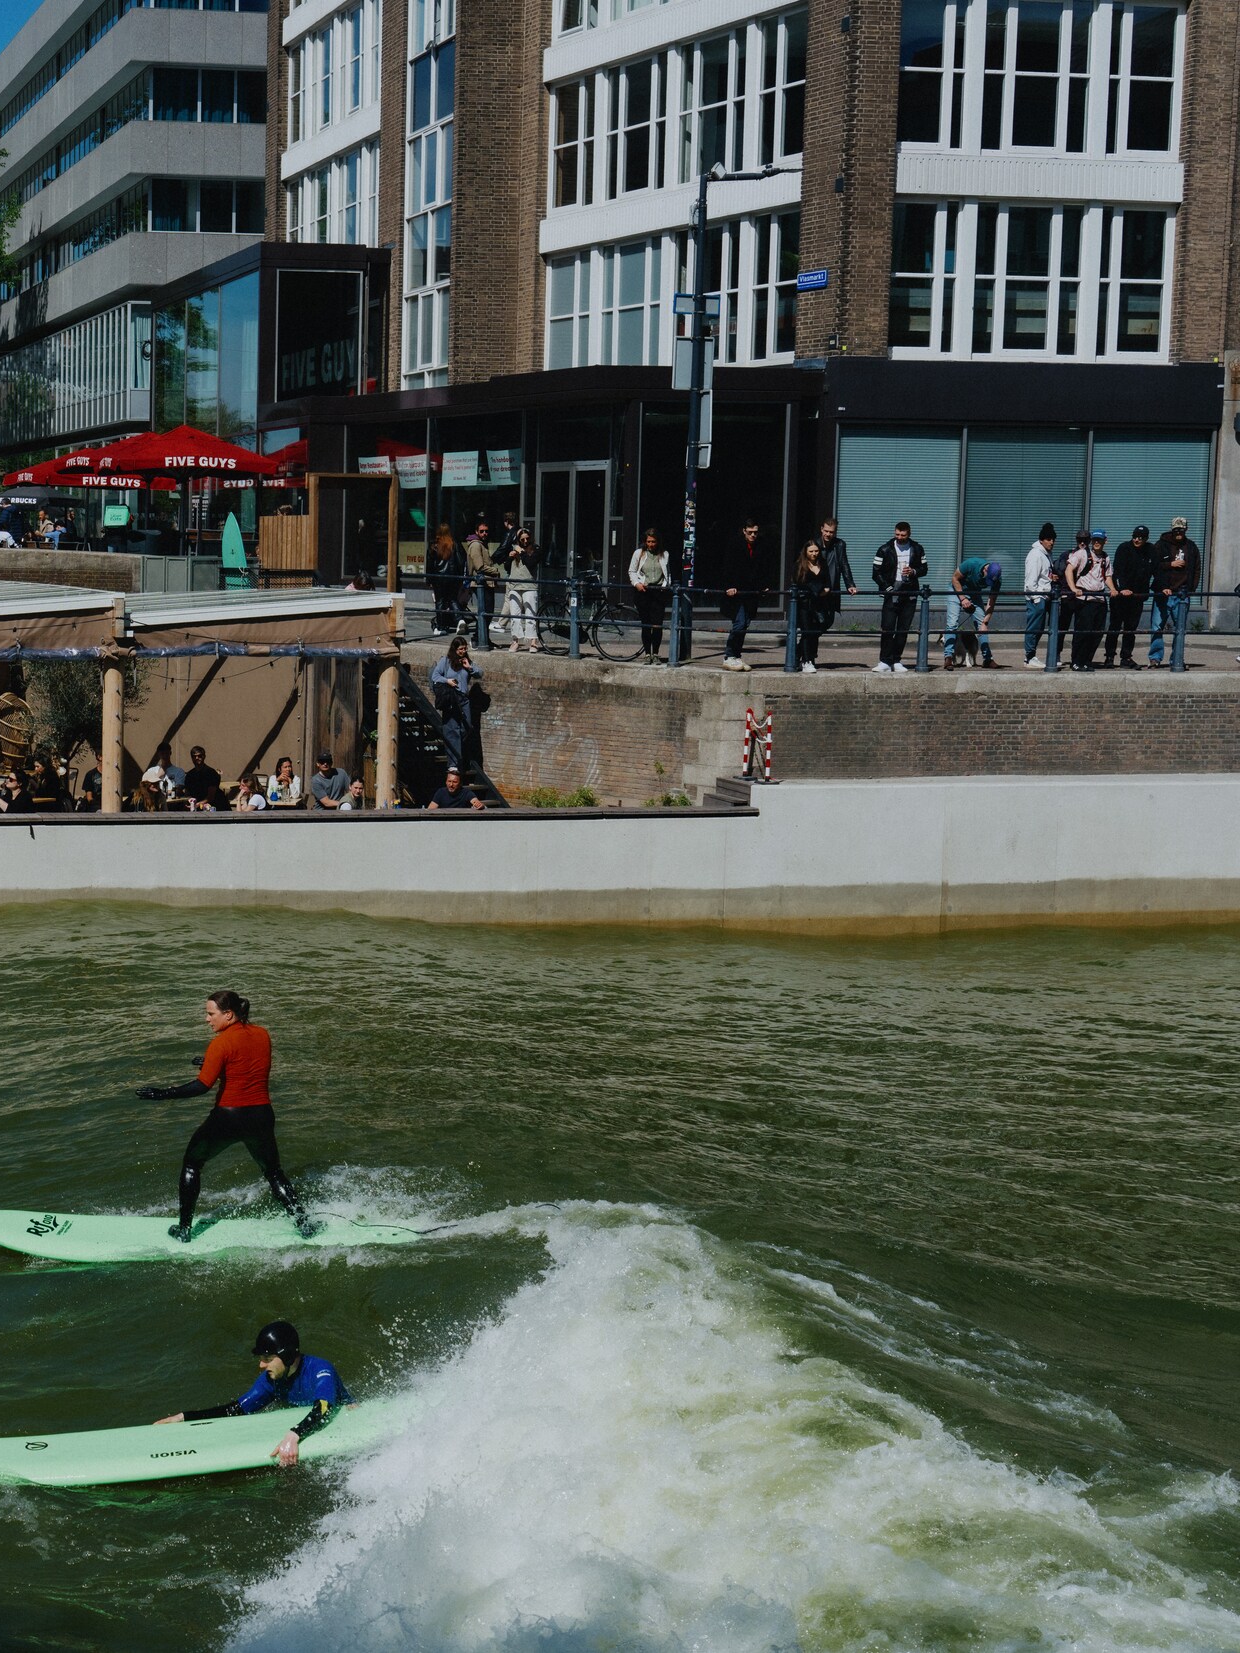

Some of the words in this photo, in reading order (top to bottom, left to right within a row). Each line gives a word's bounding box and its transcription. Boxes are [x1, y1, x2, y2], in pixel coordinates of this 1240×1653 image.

[281, 347, 316, 392] FIVE
[320, 338, 356, 385] GUY
[164, 456, 195, 467] FIVE
[198, 457, 237, 469] GUYS
[82, 476, 107, 485] FIVE
[110, 476, 141, 487] GUYS
[407, 555, 417, 563] FIVE
